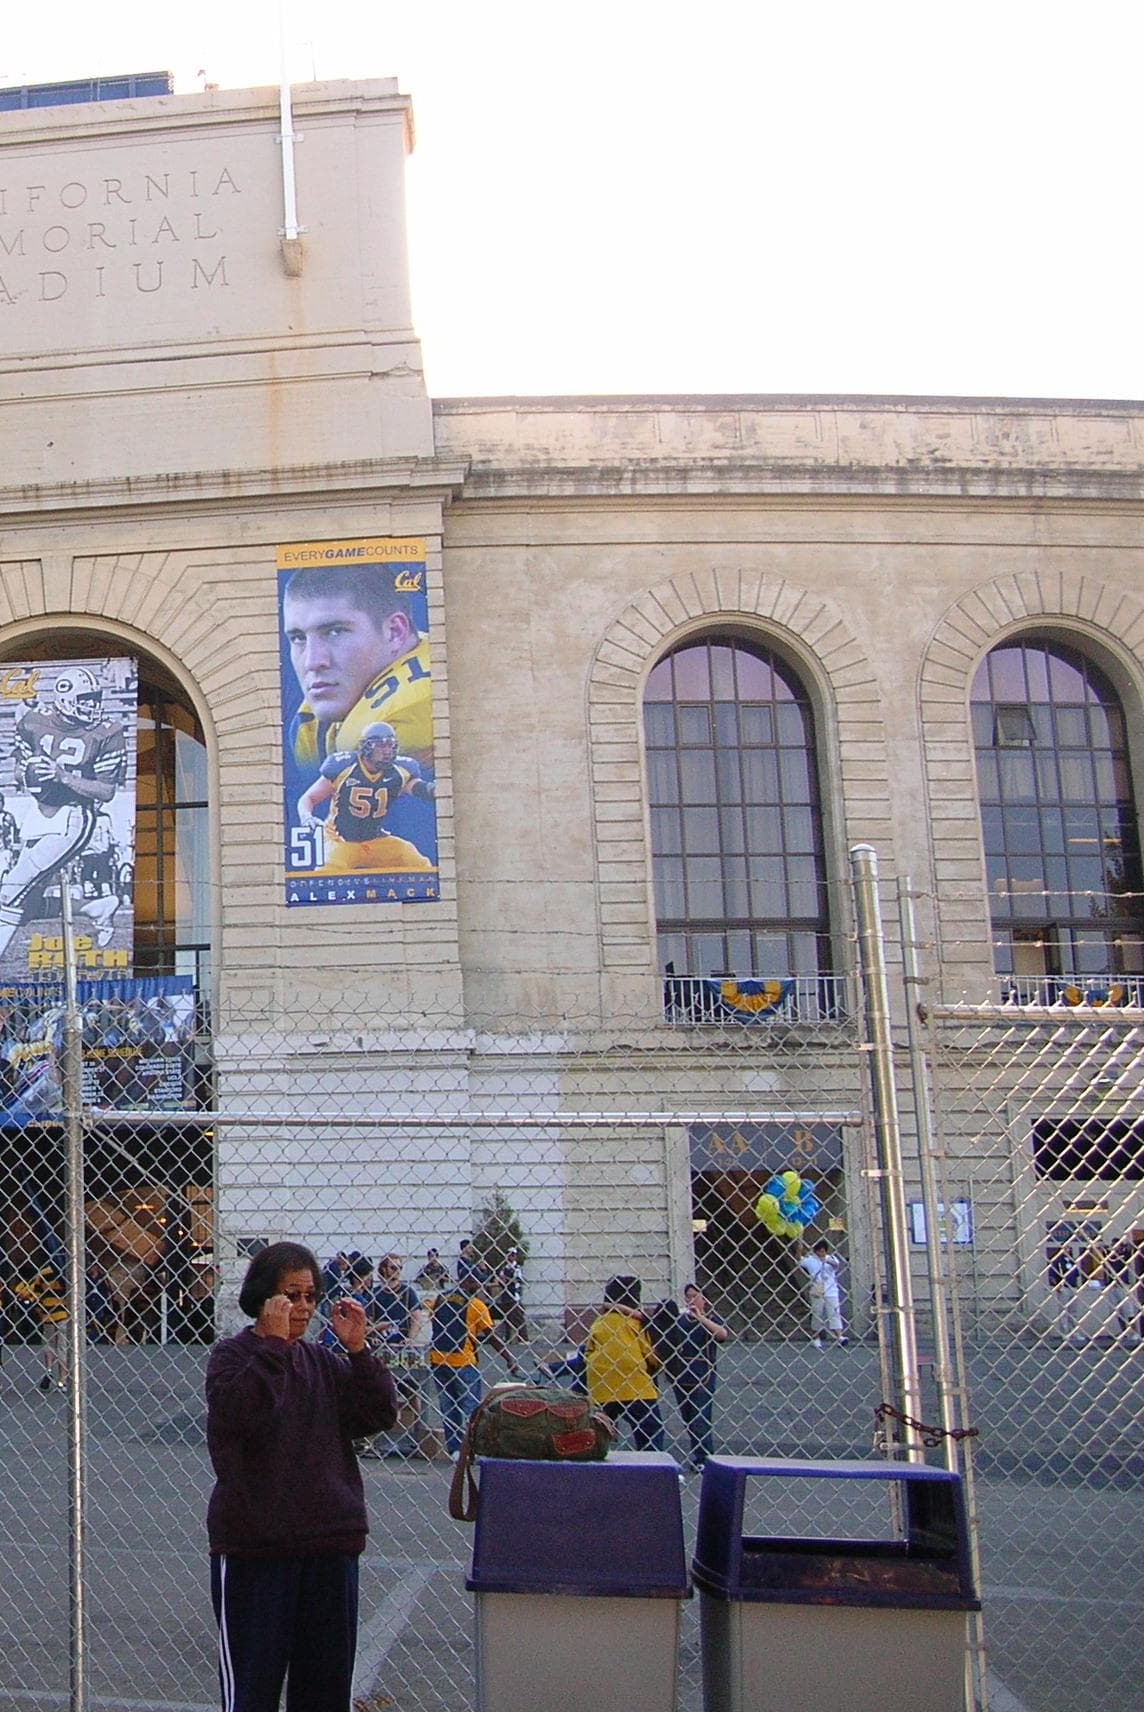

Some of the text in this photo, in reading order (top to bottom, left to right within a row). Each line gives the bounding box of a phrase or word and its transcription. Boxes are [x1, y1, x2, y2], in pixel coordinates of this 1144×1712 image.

[394, 570, 423, 592] Cal
[0, 668, 40, 699] Cal
[348, 787, 388, 818] 51
[290, 826, 323, 867] 51
[290, 886, 436, 902] ALEX MACK
